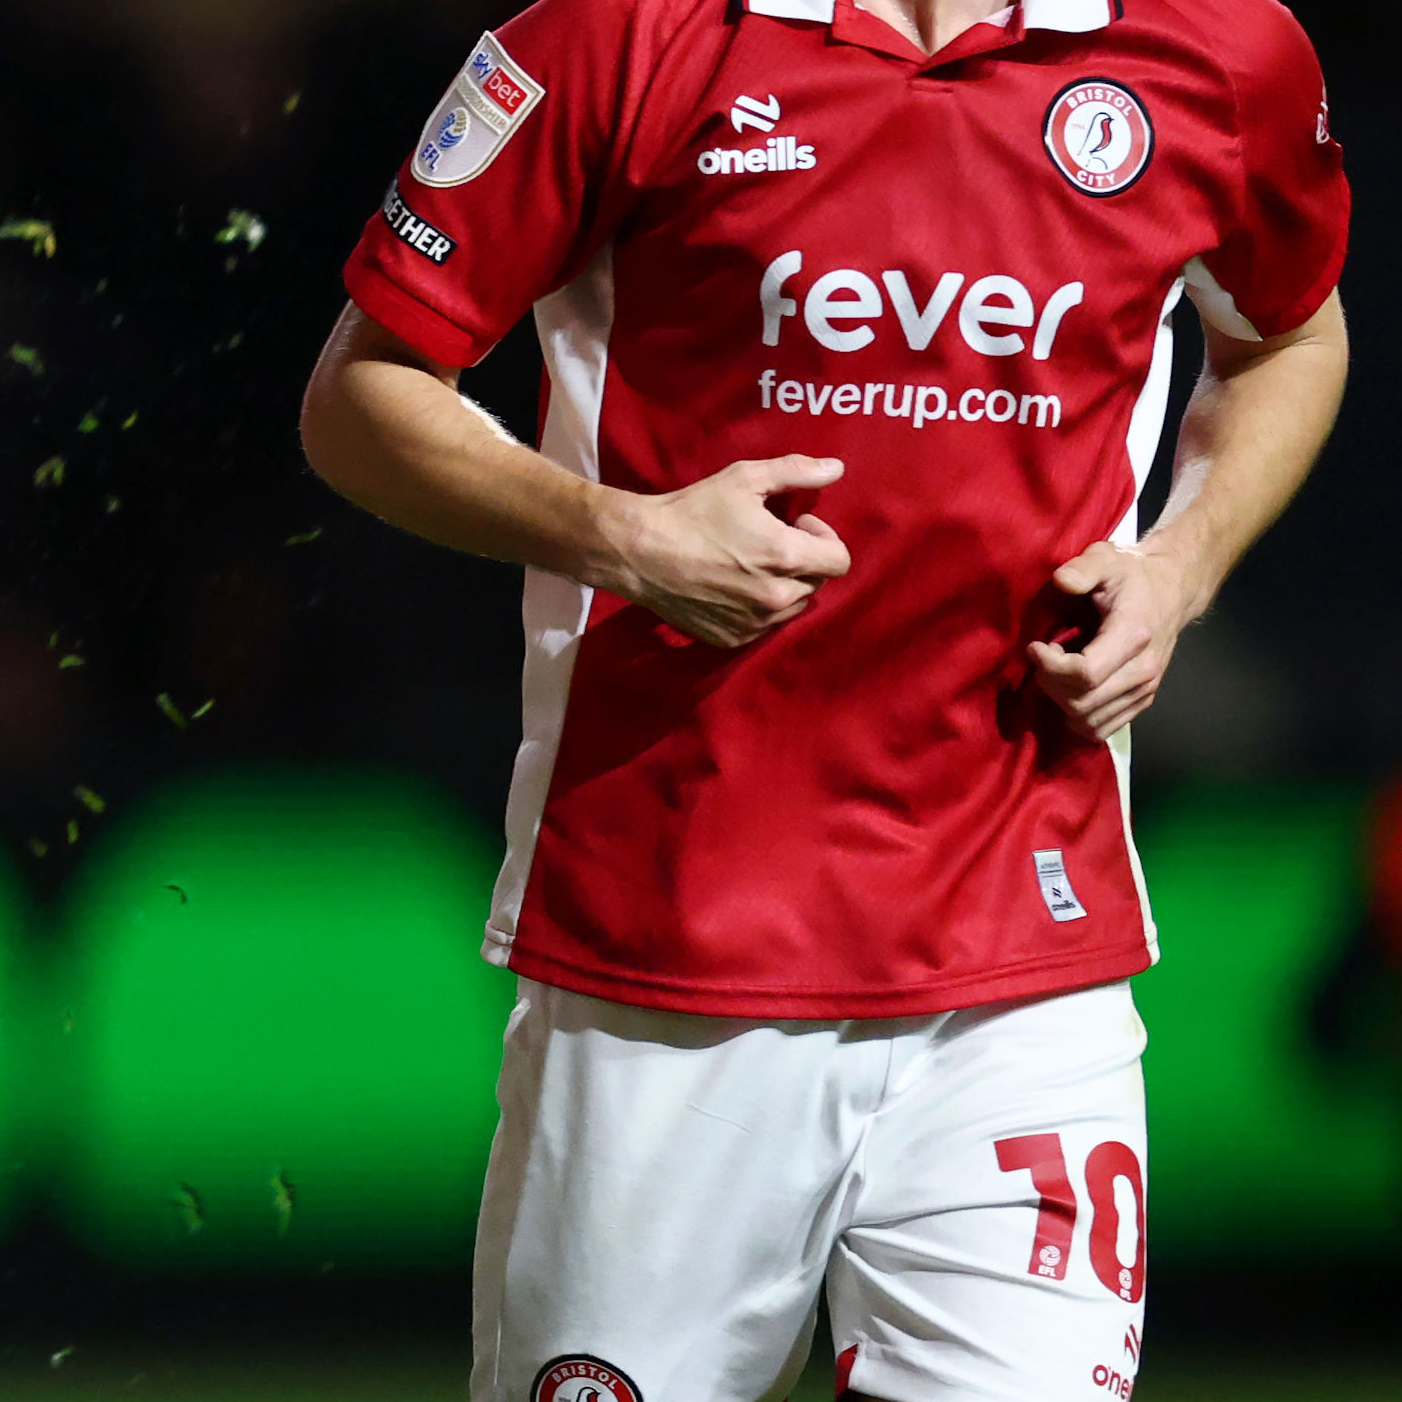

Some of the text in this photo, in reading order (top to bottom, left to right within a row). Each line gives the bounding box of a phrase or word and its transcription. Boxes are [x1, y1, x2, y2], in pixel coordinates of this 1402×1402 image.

[473, 53, 493, 79] sky
[487, 69, 521, 108] bet
[1066, 88, 1134, 117] BRISTOL
[420, 143, 440, 171] EFL
[1076, 170, 1115, 187] CITY
[759, 250, 1084, 361] fever
[757, 369, 1062, 428] feverup.com
[995, 1132, 1144, 1303] 10
[1038, 1265, 1057, 1277] EFL
[552, 1365, 619, 1390] BRISTOL
